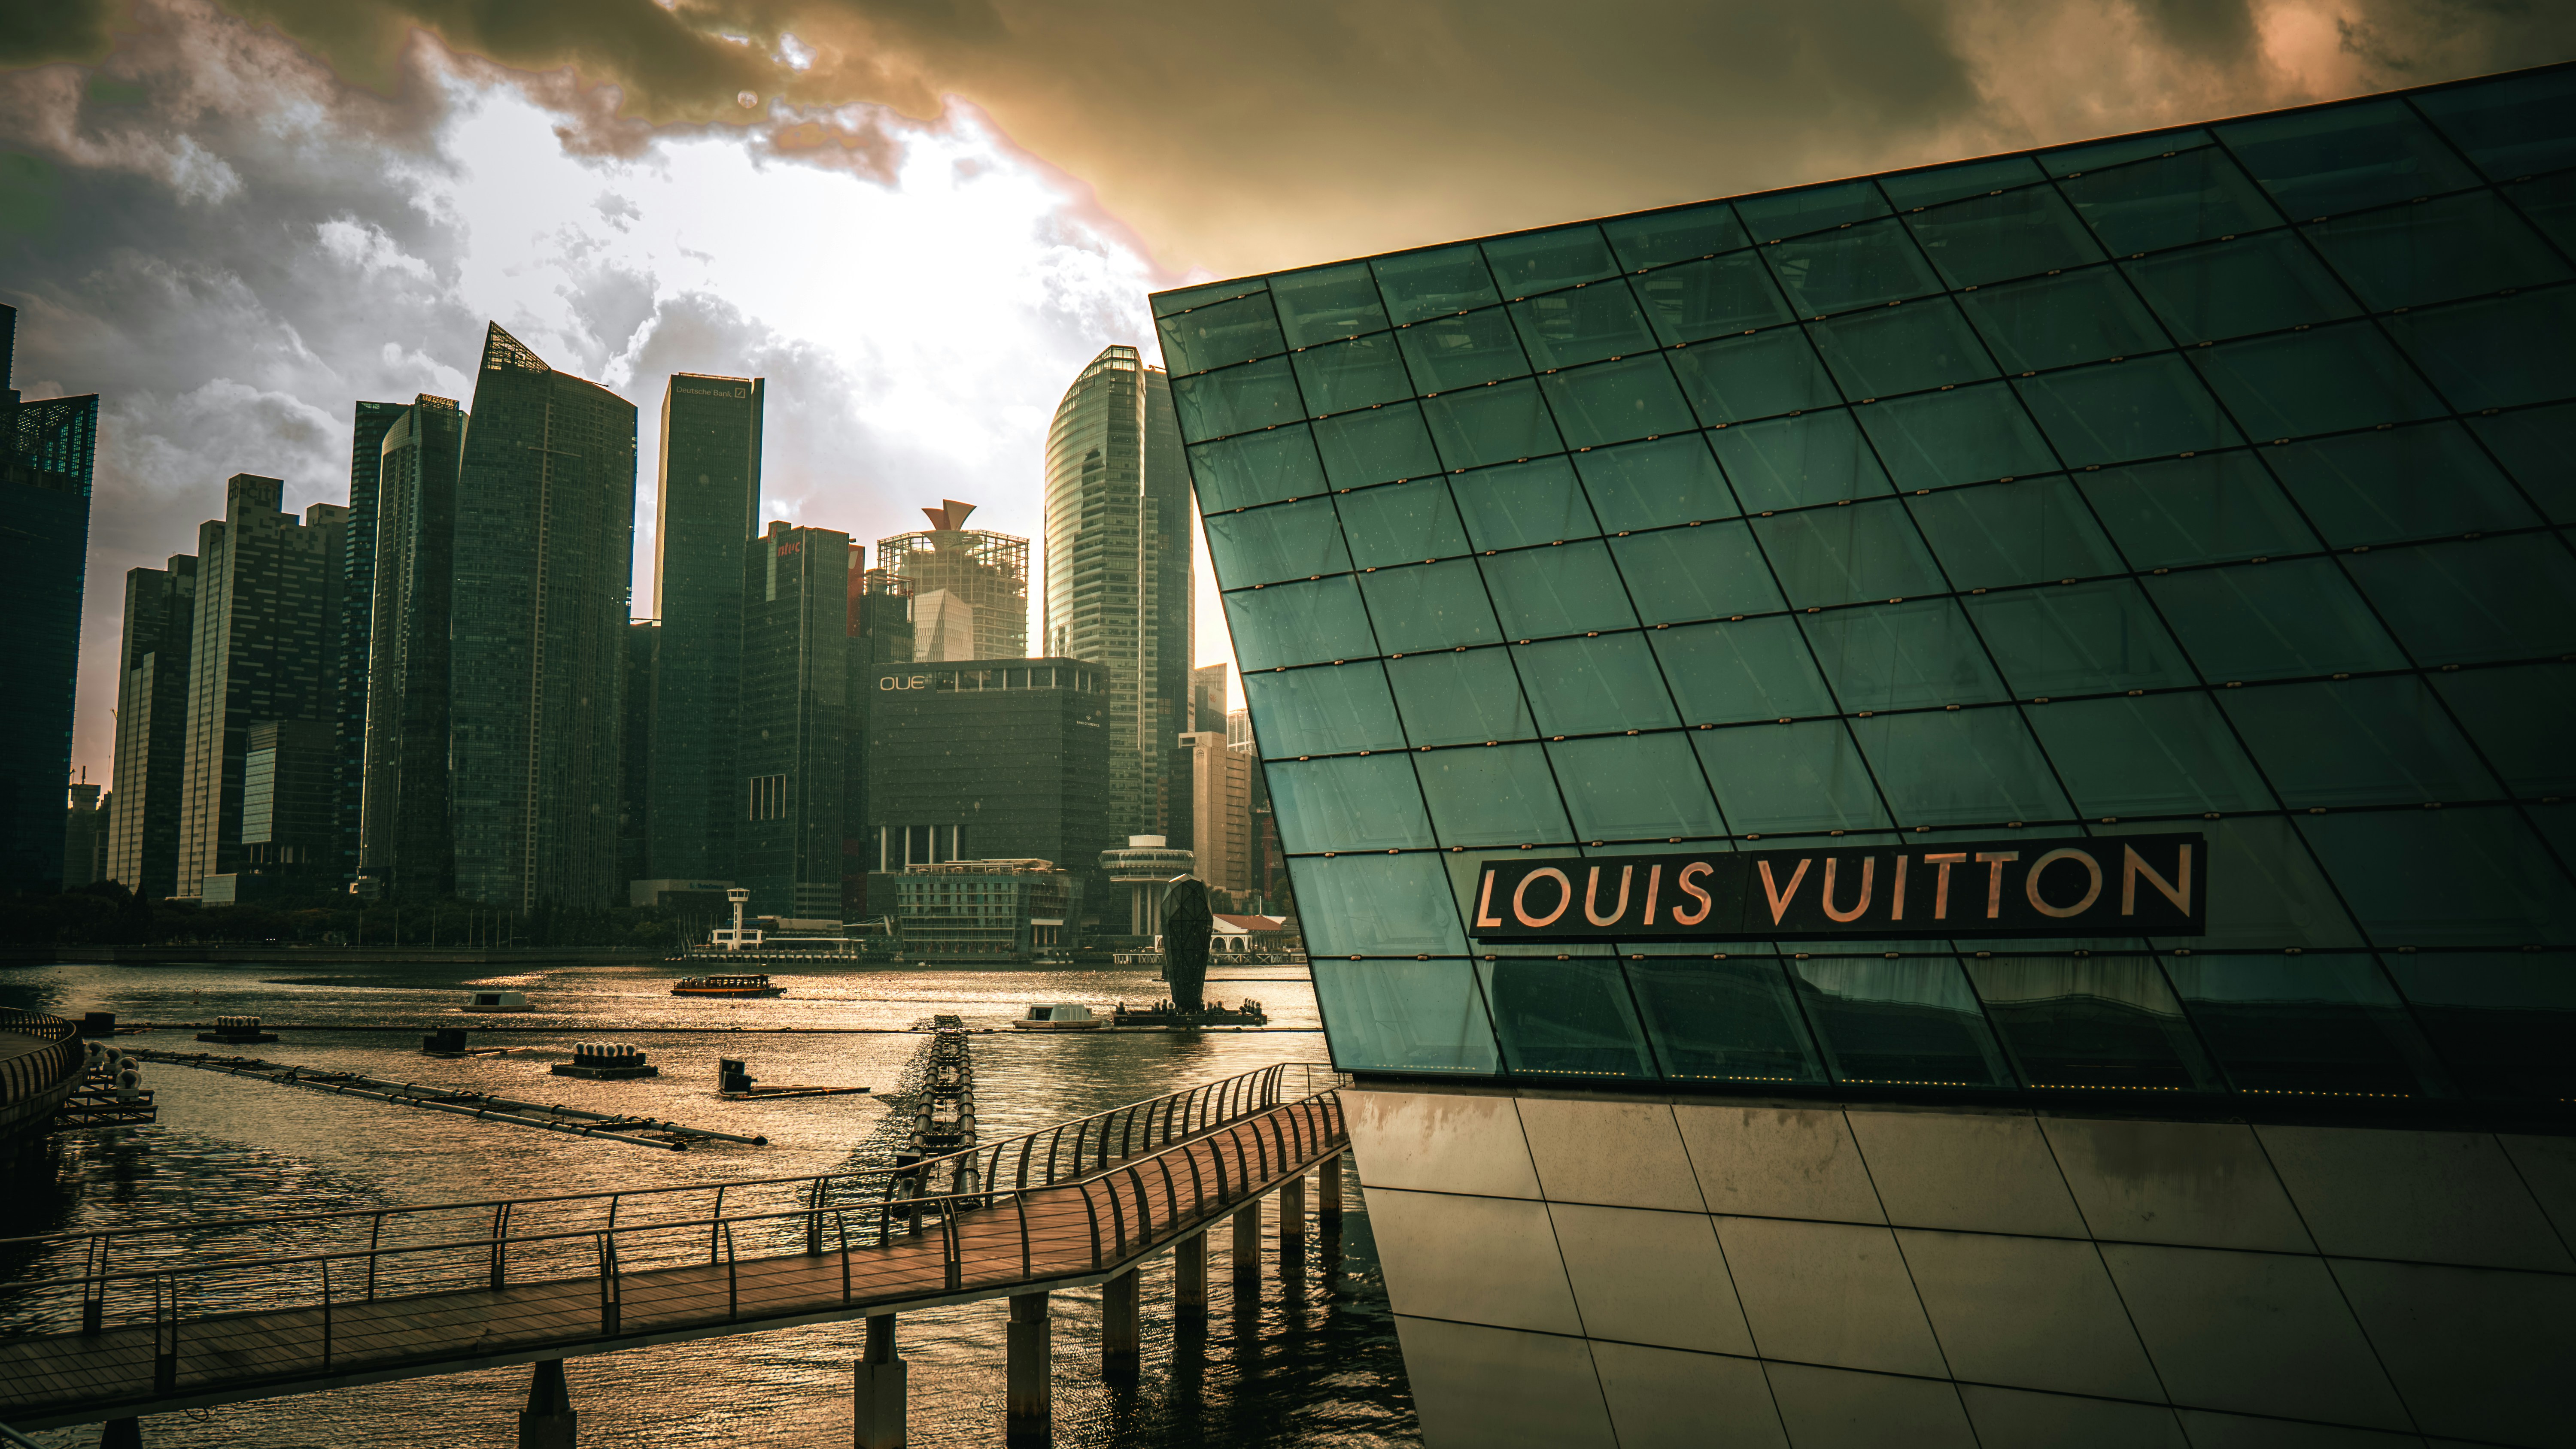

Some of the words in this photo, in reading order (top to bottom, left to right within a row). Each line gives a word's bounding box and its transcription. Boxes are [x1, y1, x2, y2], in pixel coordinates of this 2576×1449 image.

[677, 386, 711, 395] Deutsche
[11, 432, 68, 451] stndrd
[10, 442, 70, 461] cartred
[247, 485, 276, 502] citi
[778, 541, 800, 557] ntuc
[880, 676, 925, 690] OUE
[1476, 861, 1714, 927] LOUIS
[1757, 843, 2192, 927] VUITTON
